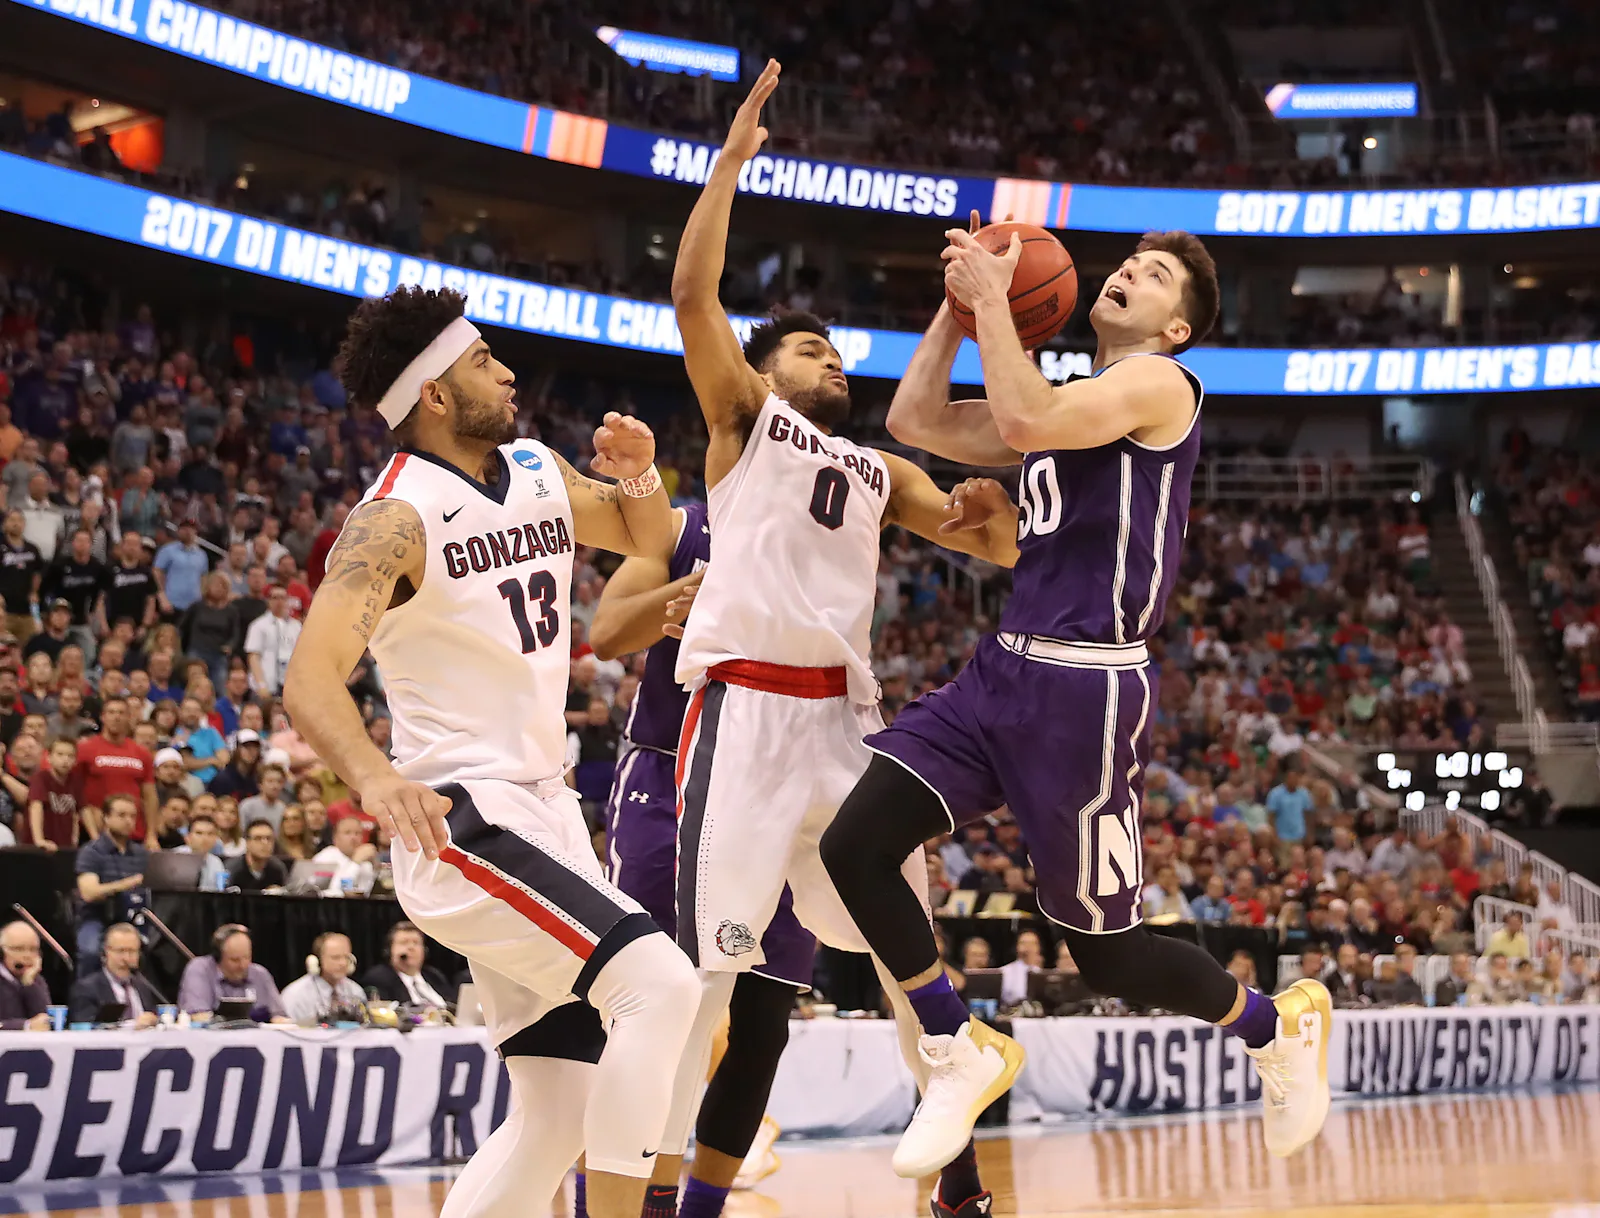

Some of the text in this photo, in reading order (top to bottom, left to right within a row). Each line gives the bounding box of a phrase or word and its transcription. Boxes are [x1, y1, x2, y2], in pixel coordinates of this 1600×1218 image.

[32, 0, 412, 114] ALL CHAMPIONSHIP
[141, 197, 232, 257] 2017
[279, 228, 392, 299] MEN'S
[1215, 193, 1299, 233] 2017
[1348, 191, 1462, 232] MEN'S
[1467, 184, 1600, 230] BASKET
[1284, 351, 1371, 392] 2017
[1421, 348, 1539, 390] MEN'S
[768, 414, 883, 498] GONAGA
[809, 465, 850, 531] 0
[443, 516, 572, 579] GONZAGA
[497, 570, 560, 654] 13
[1097, 804, 1138, 896] N
[1344, 1016, 1588, 1095] UNIVERSITY OF
[0, 1047, 402, 1183] SECOND
